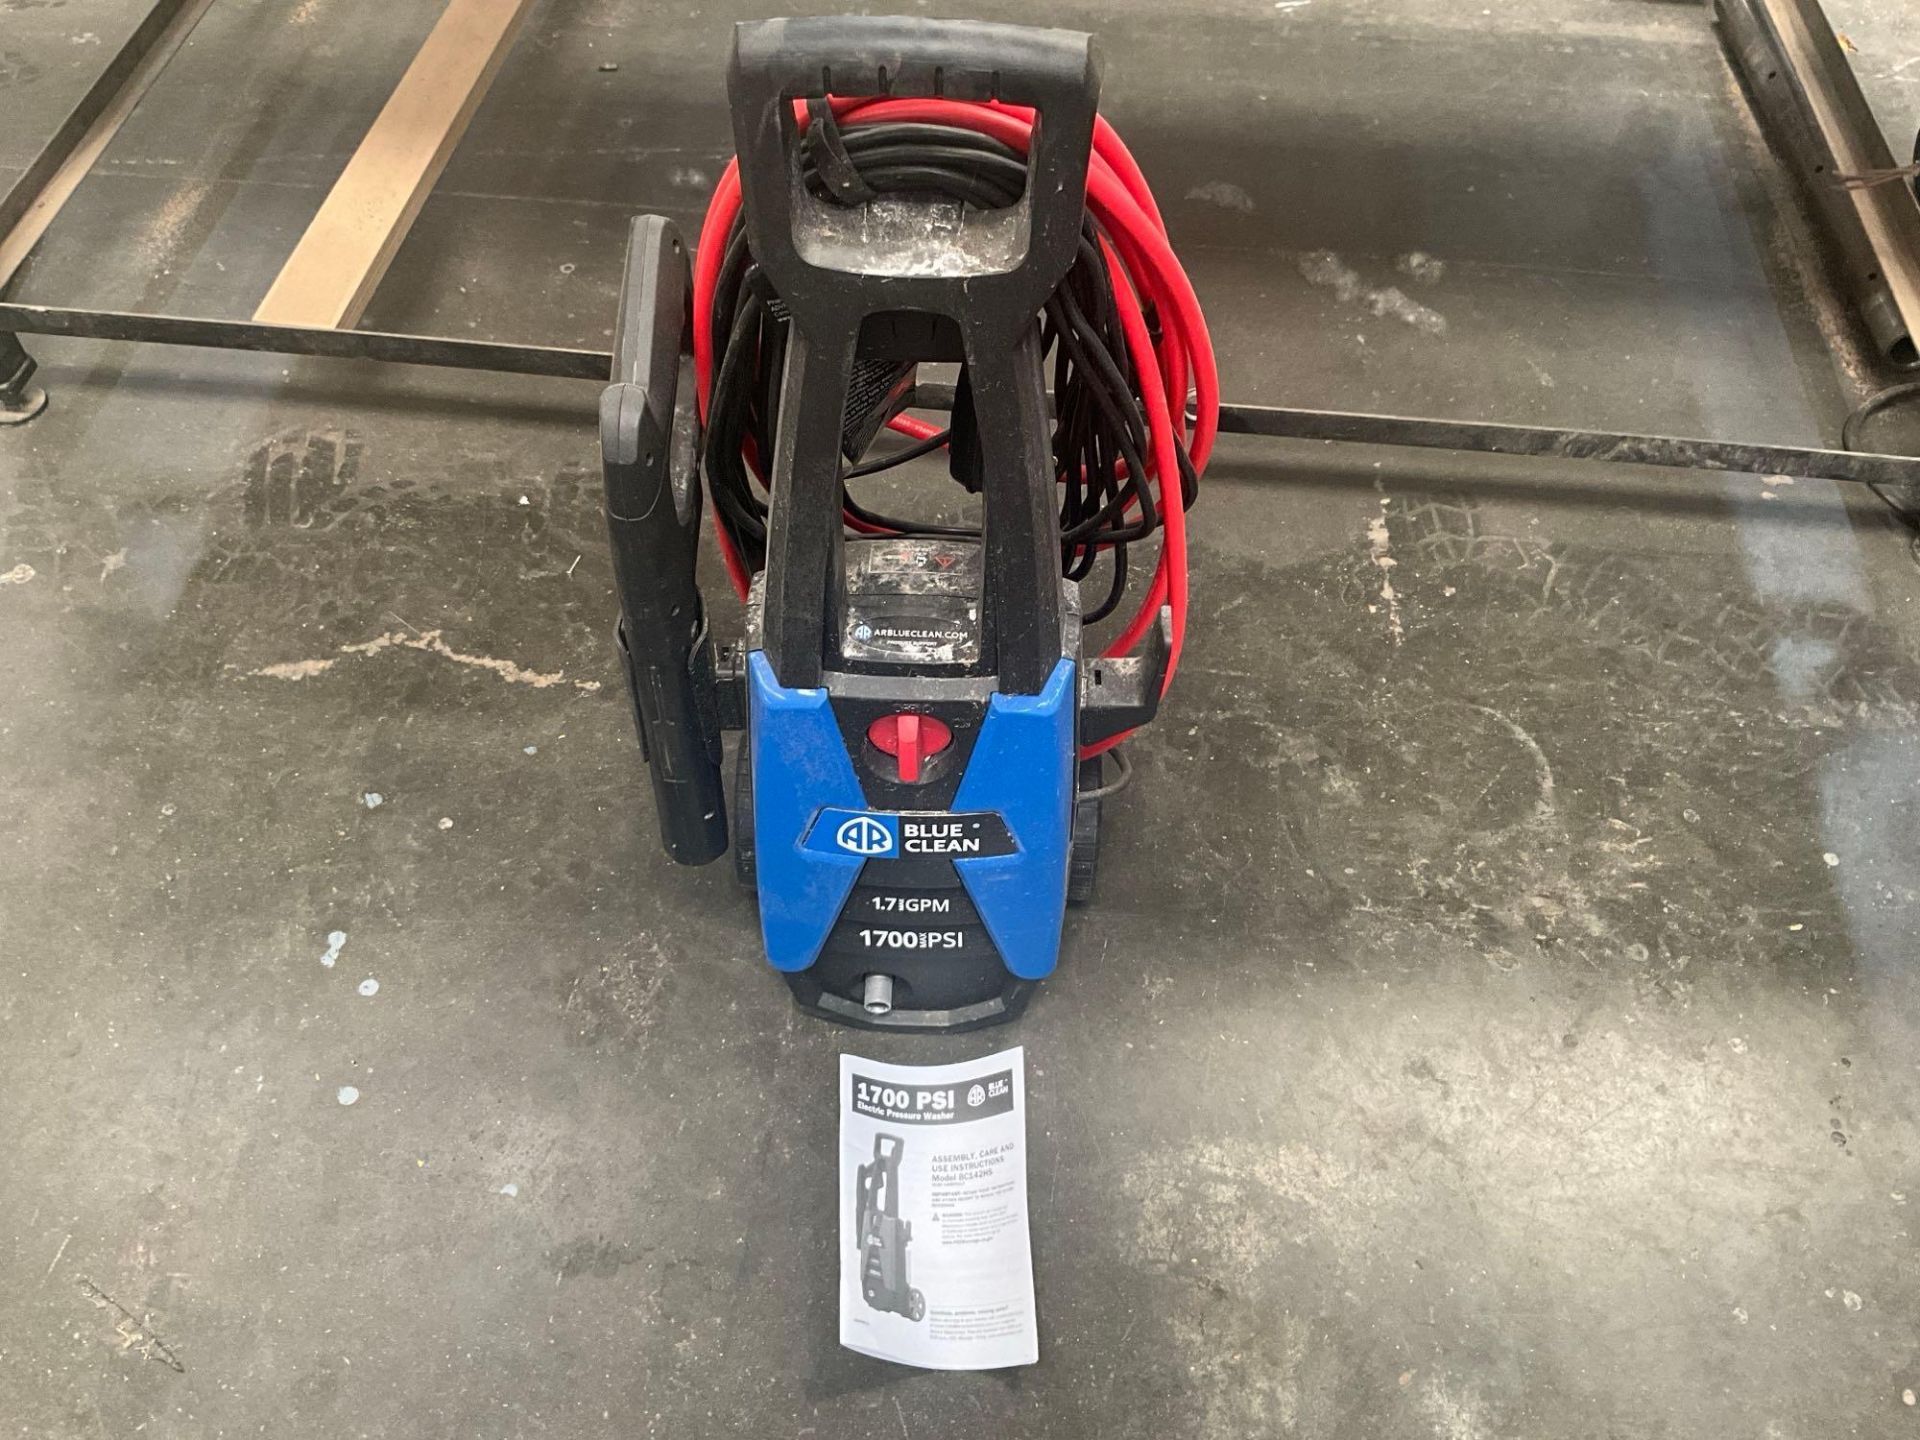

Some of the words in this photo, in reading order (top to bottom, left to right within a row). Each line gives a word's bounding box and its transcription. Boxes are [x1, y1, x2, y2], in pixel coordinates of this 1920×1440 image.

[874, 629, 968, 640] ARBLUECLEAN.COM
[904, 823, 963, 837] BLUE
[904, 838, 980, 852] CLEAN
[872, 896, 897, 911] 1.7
[905, 898, 950, 912] GPM
[860, 929, 918, 948] 1700
[928, 931, 963, 948] PSI
[857, 1082, 910, 1109] 1700
[916, 1089, 954, 1110] PSI
[857, 1101, 885, 1116] Electric
[886, 1108, 922, 1120] Pressure
[923, 1111, 954, 1120] Washer
[931, 1152, 978, 1163] ASSEMBLY,
[979, 1146, 999, 1158] CARE
[1000, 1142, 1014, 1153] AND
[931, 1164, 948, 1173] USE
[950, 1155, 1005, 1172] INSTRUCTIONS
[931, 1173, 956, 1182] Model
